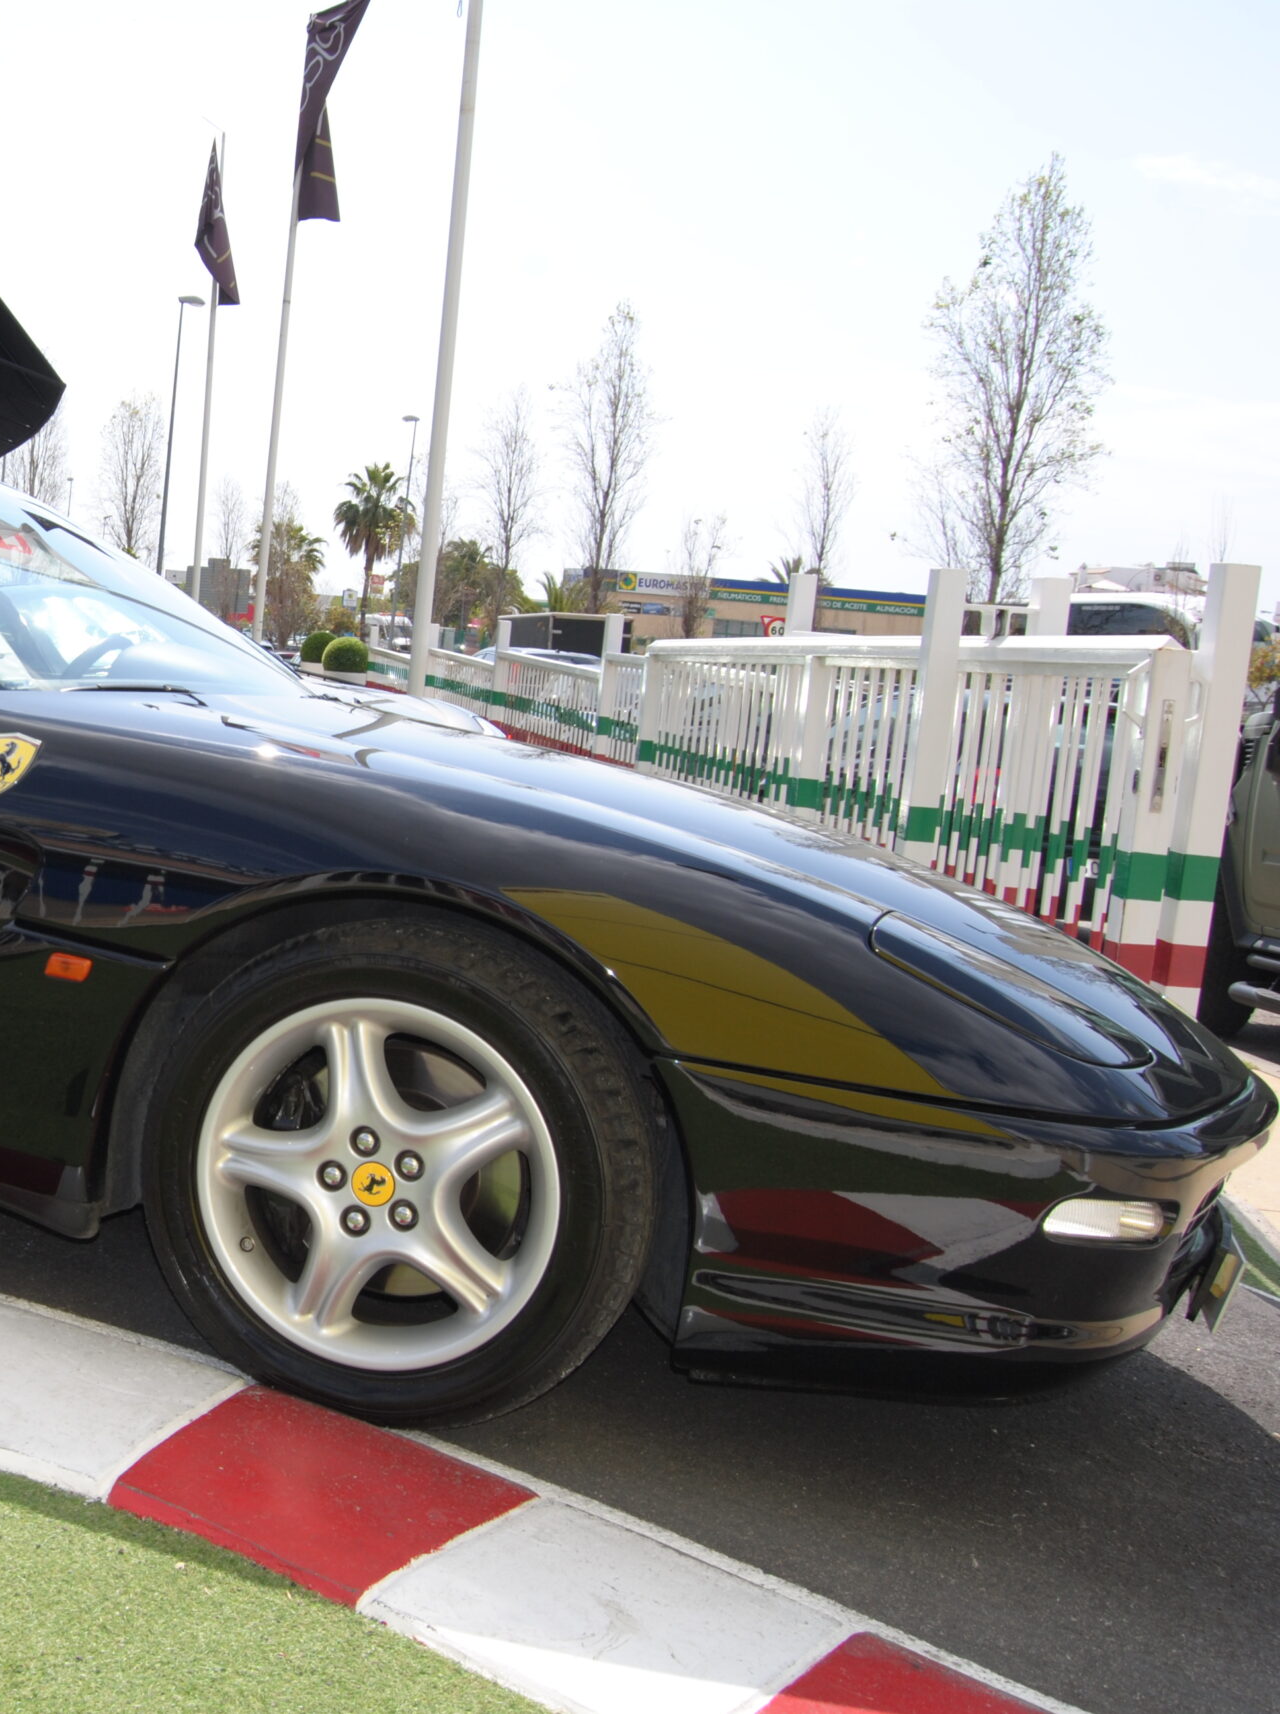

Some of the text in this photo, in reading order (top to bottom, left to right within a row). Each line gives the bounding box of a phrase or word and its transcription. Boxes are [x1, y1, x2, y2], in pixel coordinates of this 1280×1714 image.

[718, 592, 762, 602] NEUMÁTICOS
[844, 602, 868, 611] ACEITE
[875, 605, 918, 615] ALINEACIÓN
[770, 626, 785, 636] 60
